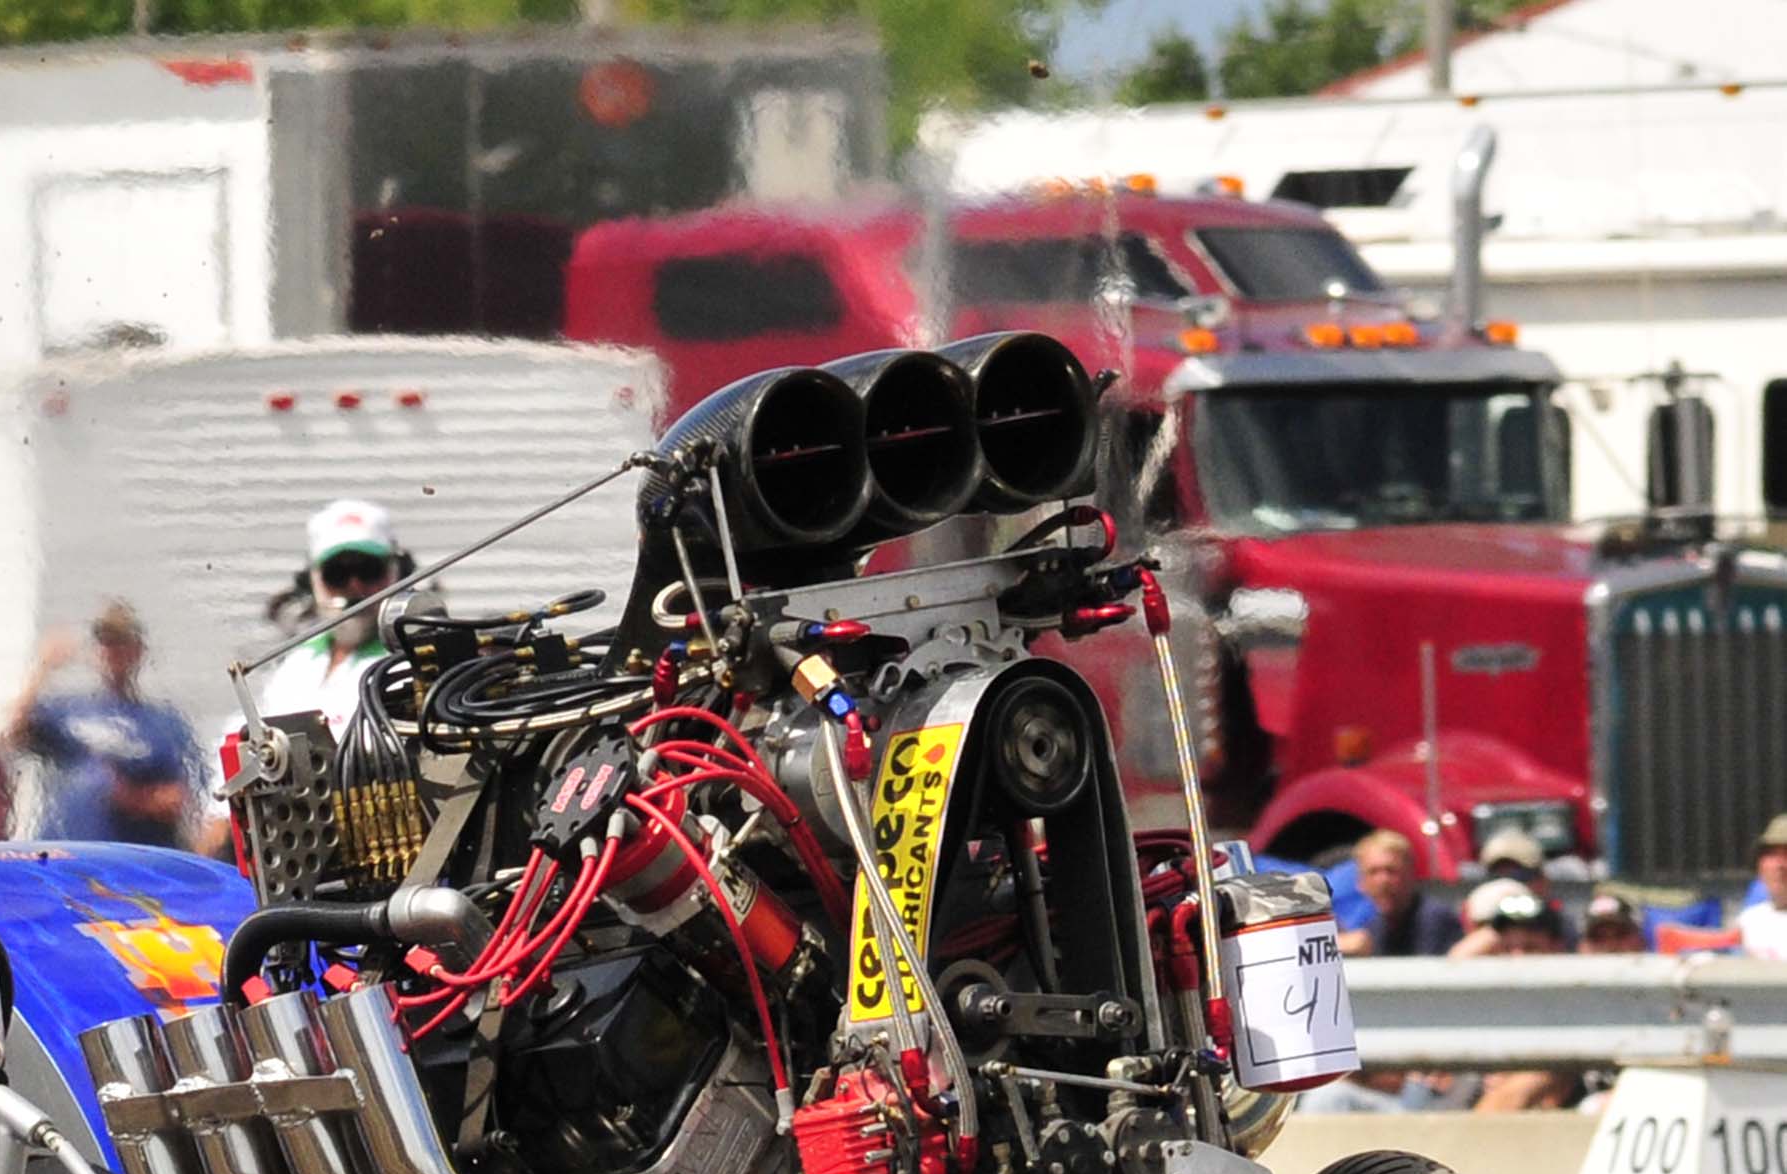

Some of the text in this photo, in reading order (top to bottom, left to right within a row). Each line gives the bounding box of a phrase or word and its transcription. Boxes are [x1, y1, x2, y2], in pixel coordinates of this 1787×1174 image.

[1299, 934, 1341, 967] NTPA
[1283, 976, 1340, 1034] 41
[1607, 1116, 1687, 1174] 100
